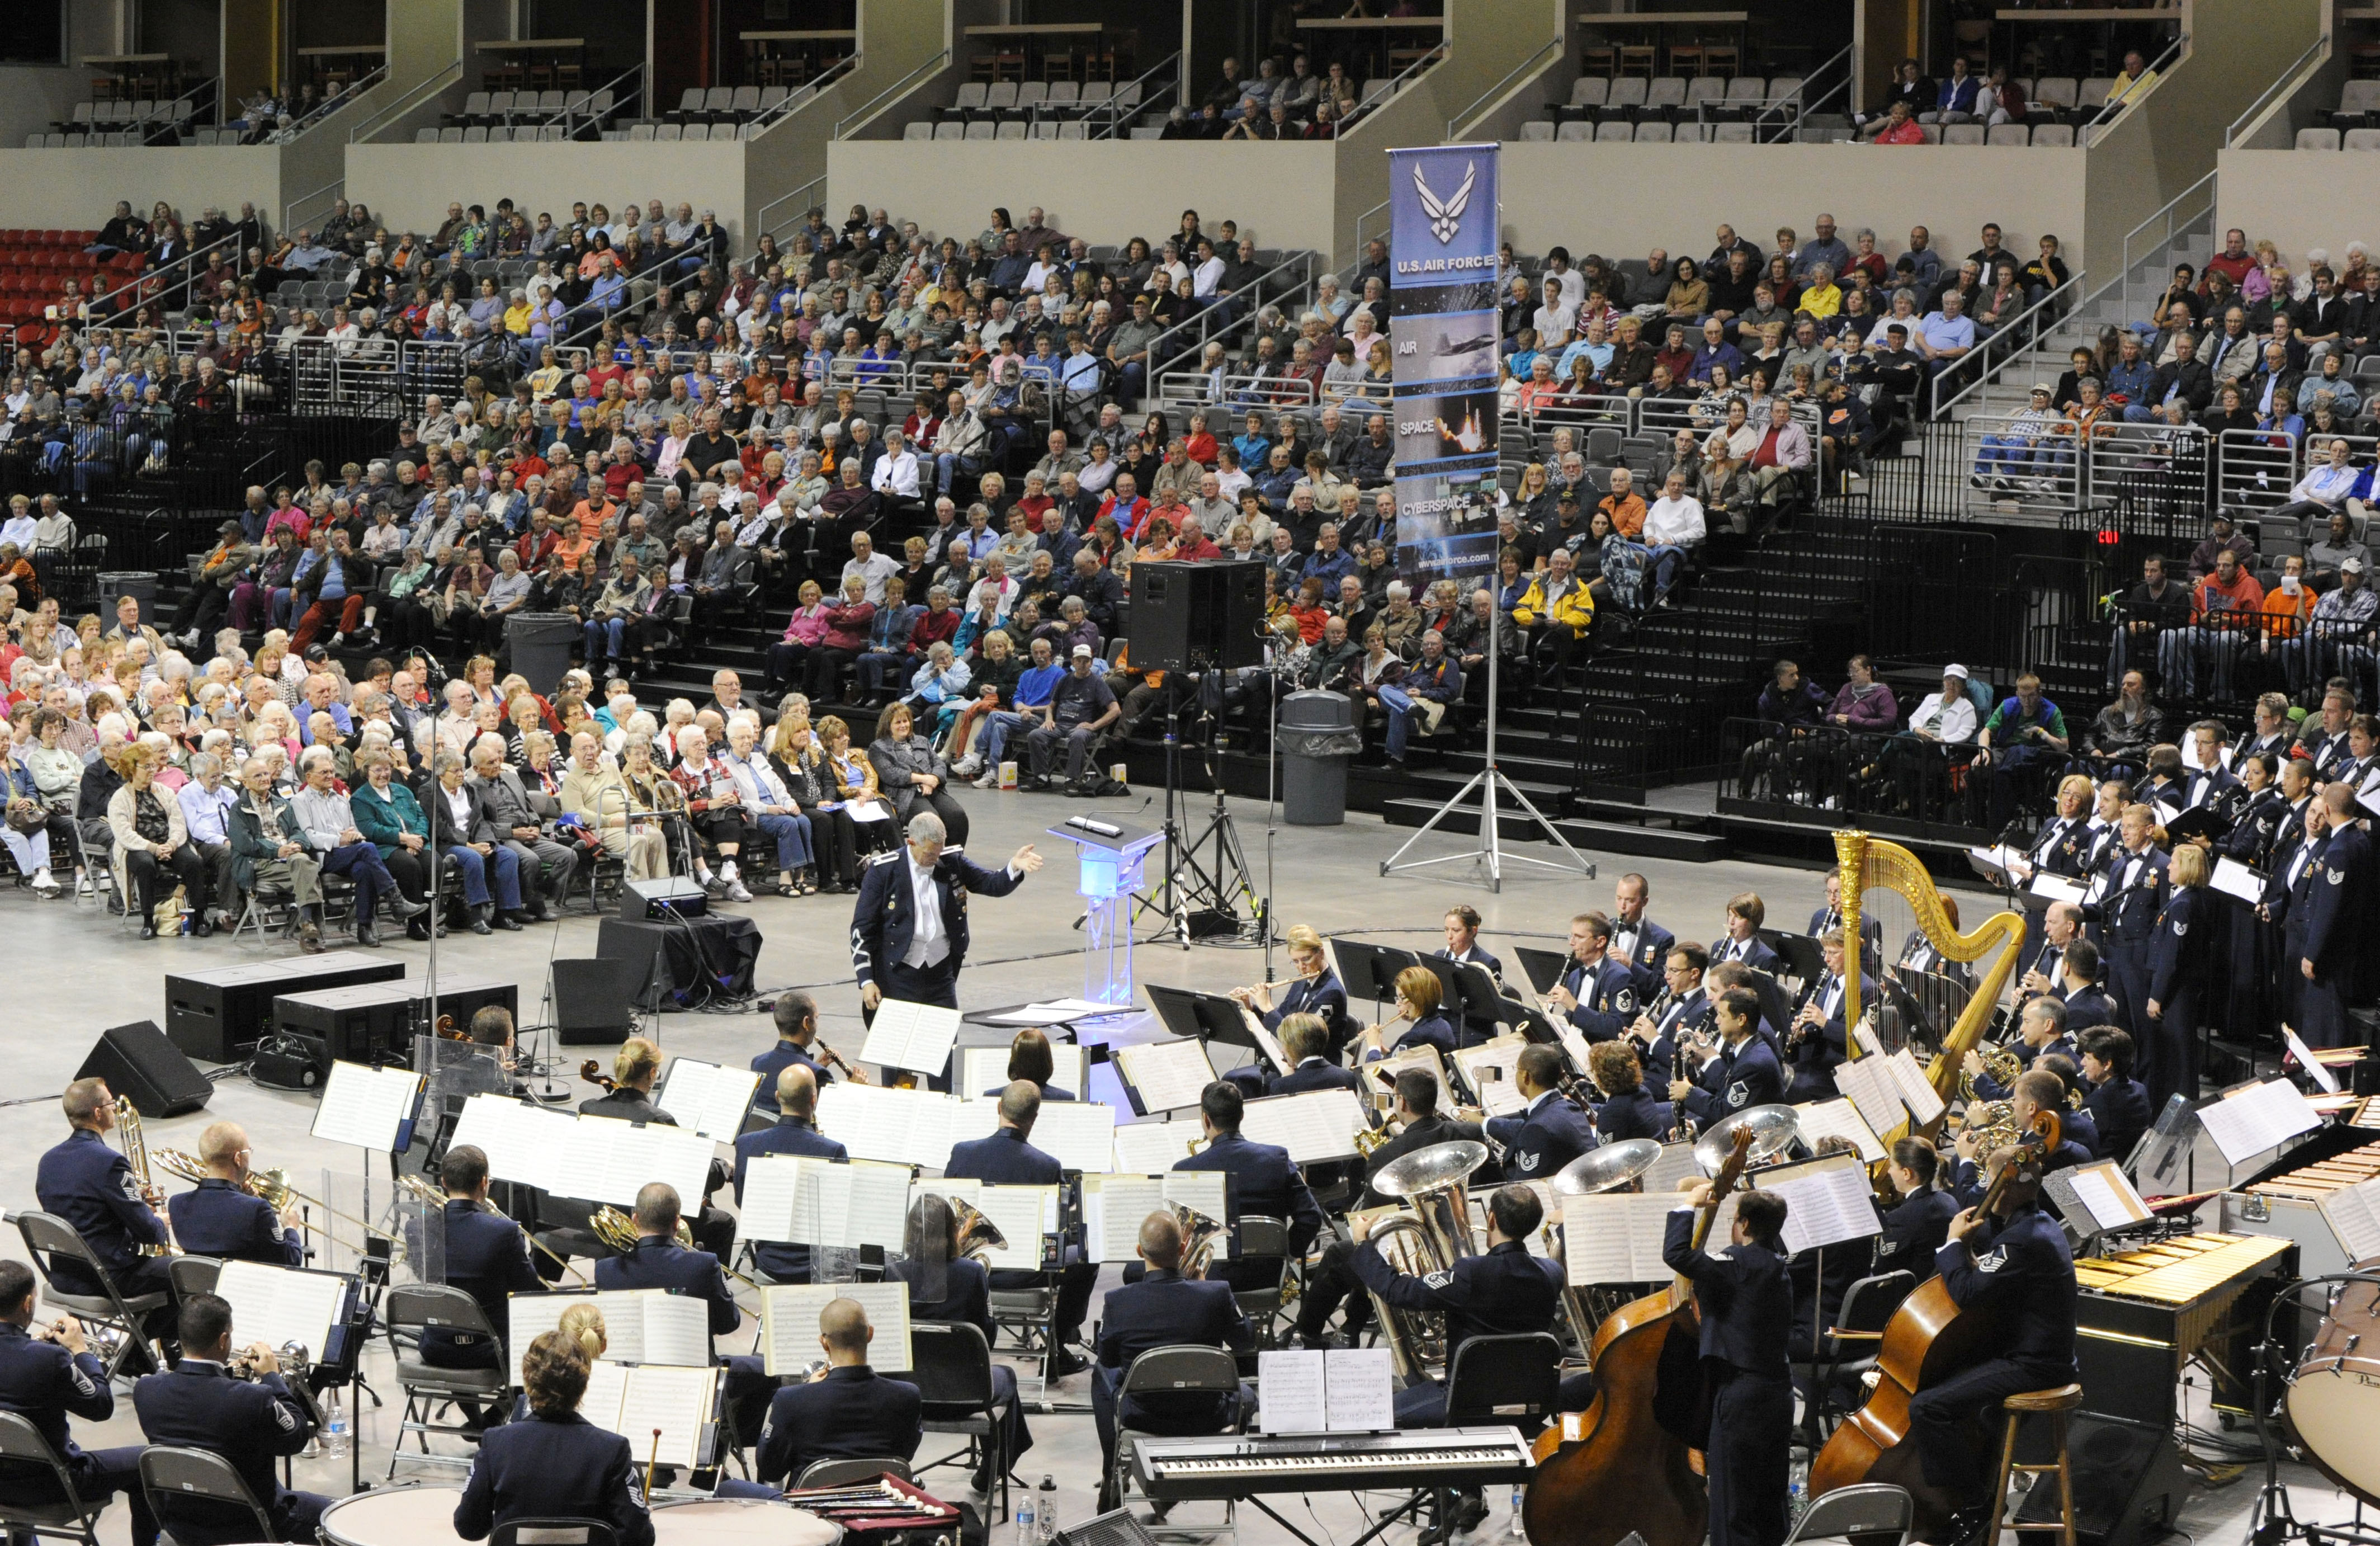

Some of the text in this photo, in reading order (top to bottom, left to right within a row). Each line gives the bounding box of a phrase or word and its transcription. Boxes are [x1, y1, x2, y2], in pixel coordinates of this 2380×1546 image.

[1397, 254, 1495, 273] U.S. AIR FORCE
[1398, 341, 1418, 354] AIR
[1400, 420, 1434, 435] SPACE
[1402, 496, 1471, 516] CYBERSPACE
[1418, 553, 1490, 569] www.airforce.com
